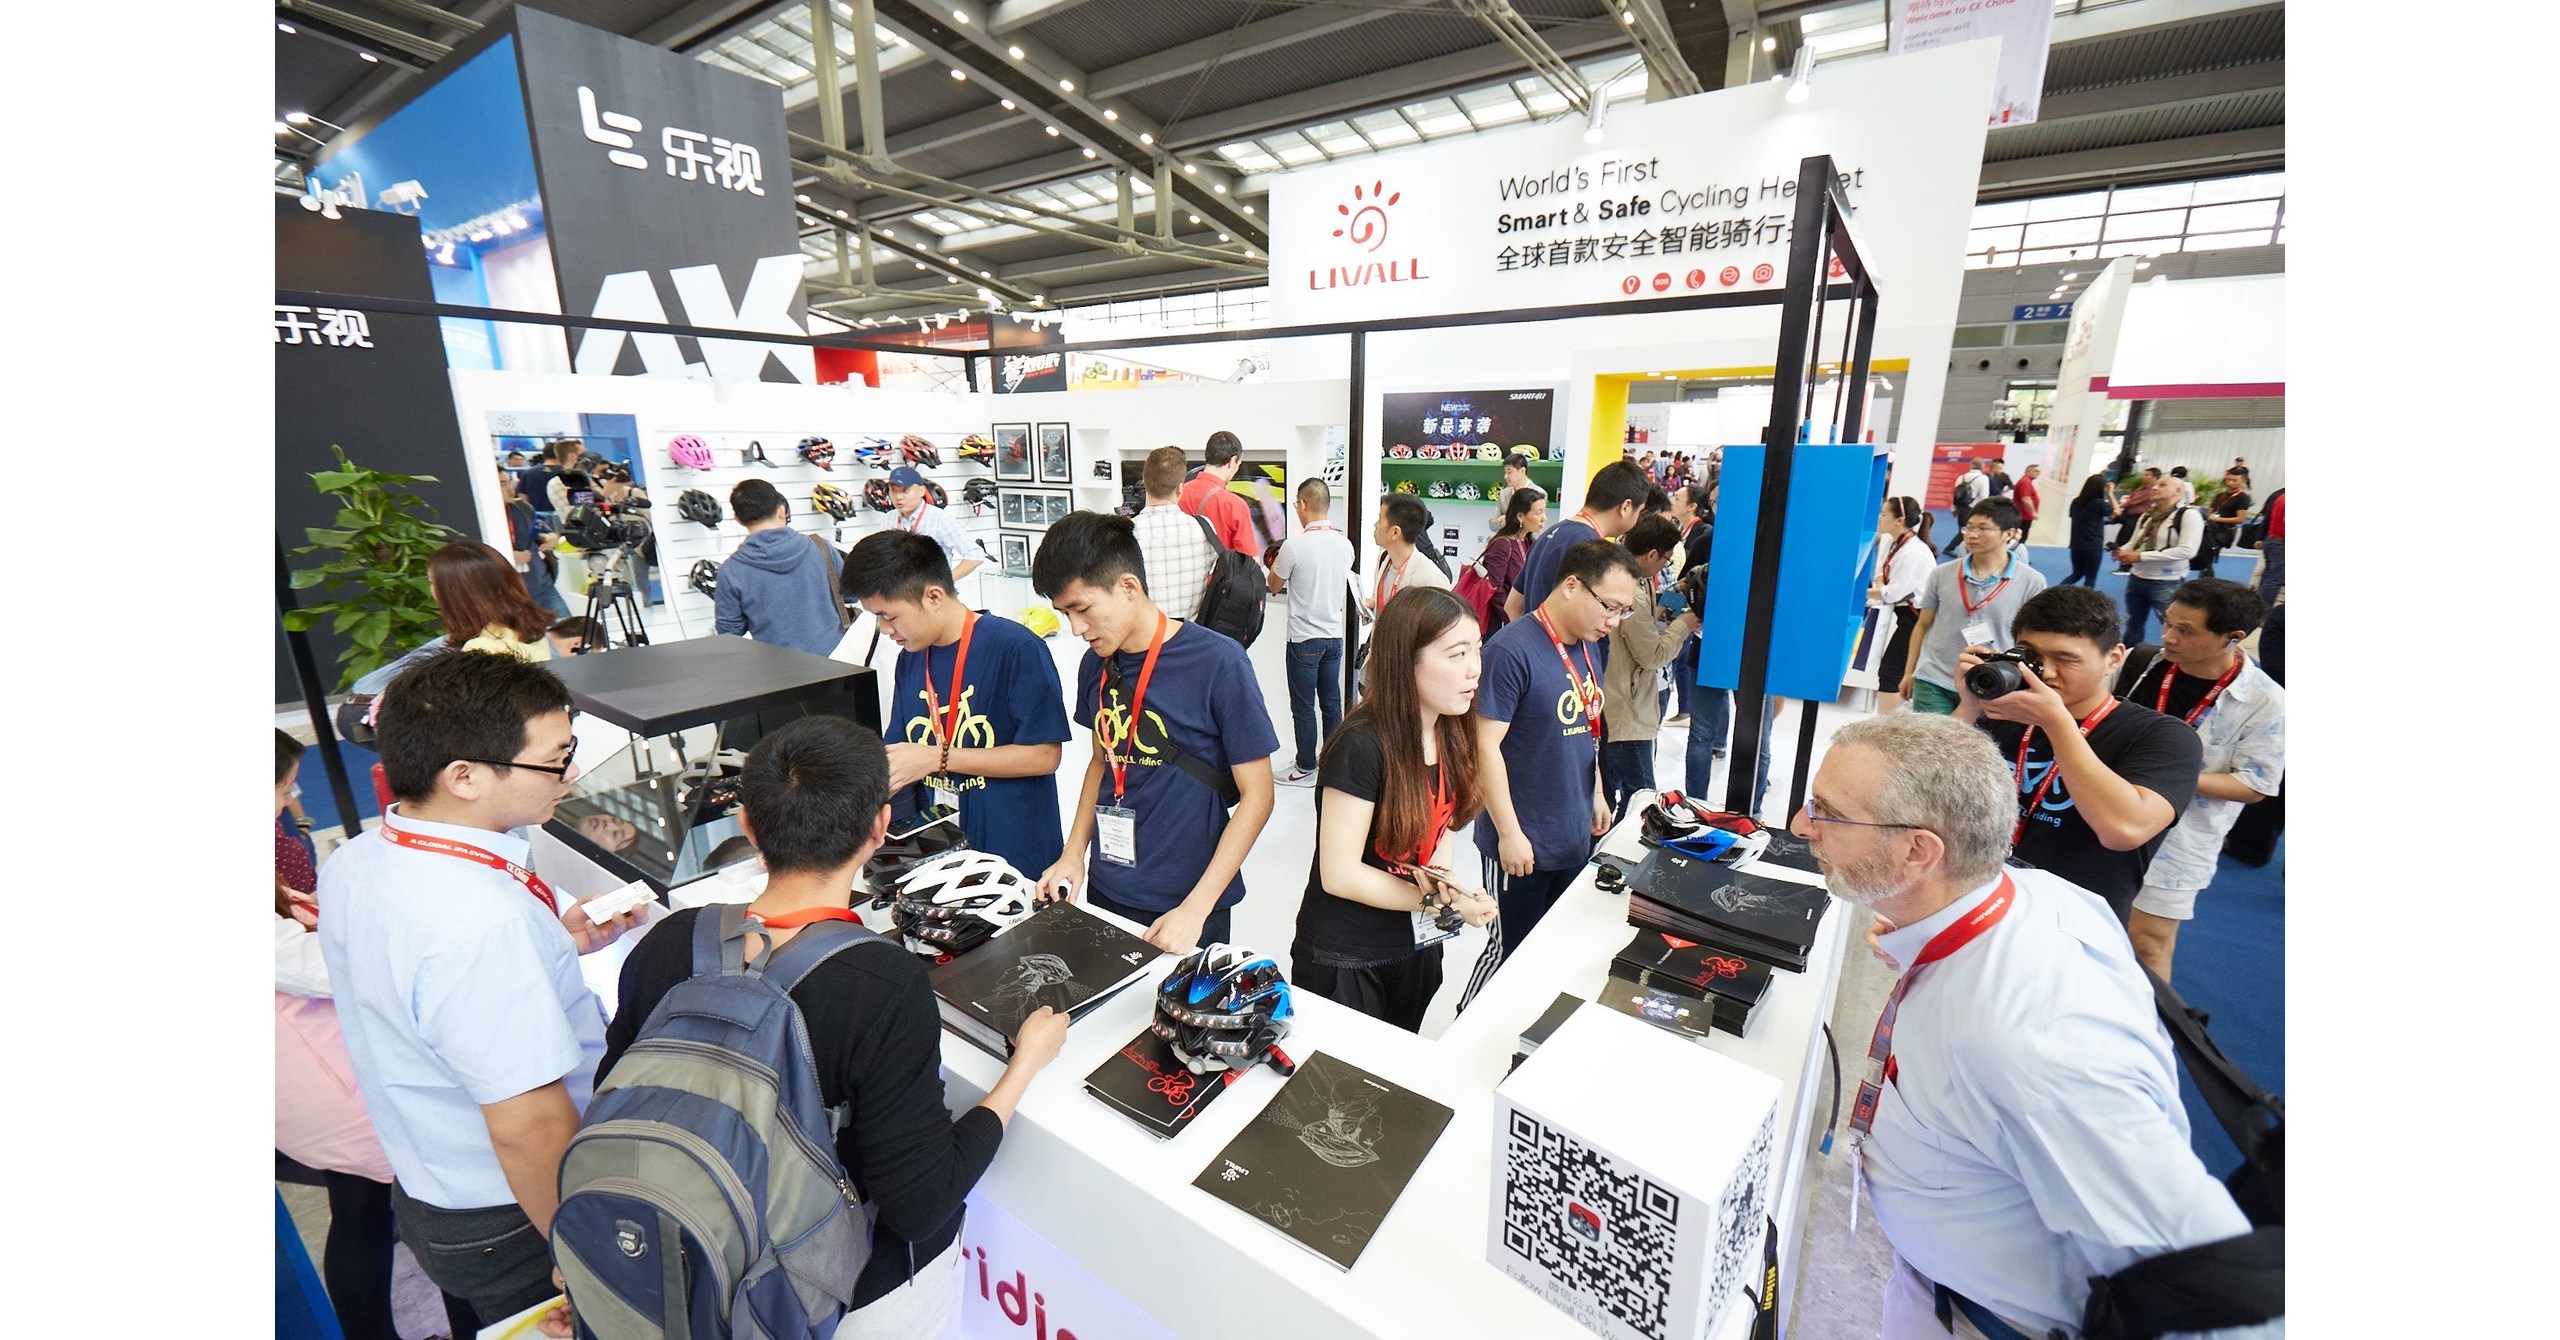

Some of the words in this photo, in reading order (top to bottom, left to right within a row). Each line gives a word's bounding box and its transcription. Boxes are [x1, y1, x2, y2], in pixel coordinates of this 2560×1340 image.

[1906, 10, 1951, 24] Welcome
[1969, 2, 1982, 11] CE
[662, 127, 765, 196] 乐视
[1602, 157, 1659, 187] First
[1498, 209, 1568, 234] Smart
[1574, 202, 1590, 224] &
[1599, 196, 1651, 220] Safe
[1661, 184, 1750, 217] Cycling
[1760, 167, 1864, 201] Heet
[1497, 207, 1857, 272] 全球首款安全智能骑行
[1310, 258, 1429, 290] LIVALL
[2024, 307, 2034, 319] 2
[1509, 393, 1547, 401] SMART4U
[1422, 417, 1492, 435] 新品来袭
[2032, 812, 2062, 827] riding
[417, 841, 453, 851] GLOBAL
[1224, 1158, 1250, 1177] LIVALL
[1506, 1264, 1543, 1295] Follow
[1577, 1312, 1597, 1332] On
[1763, 1266, 1776, 1310] Nikon
